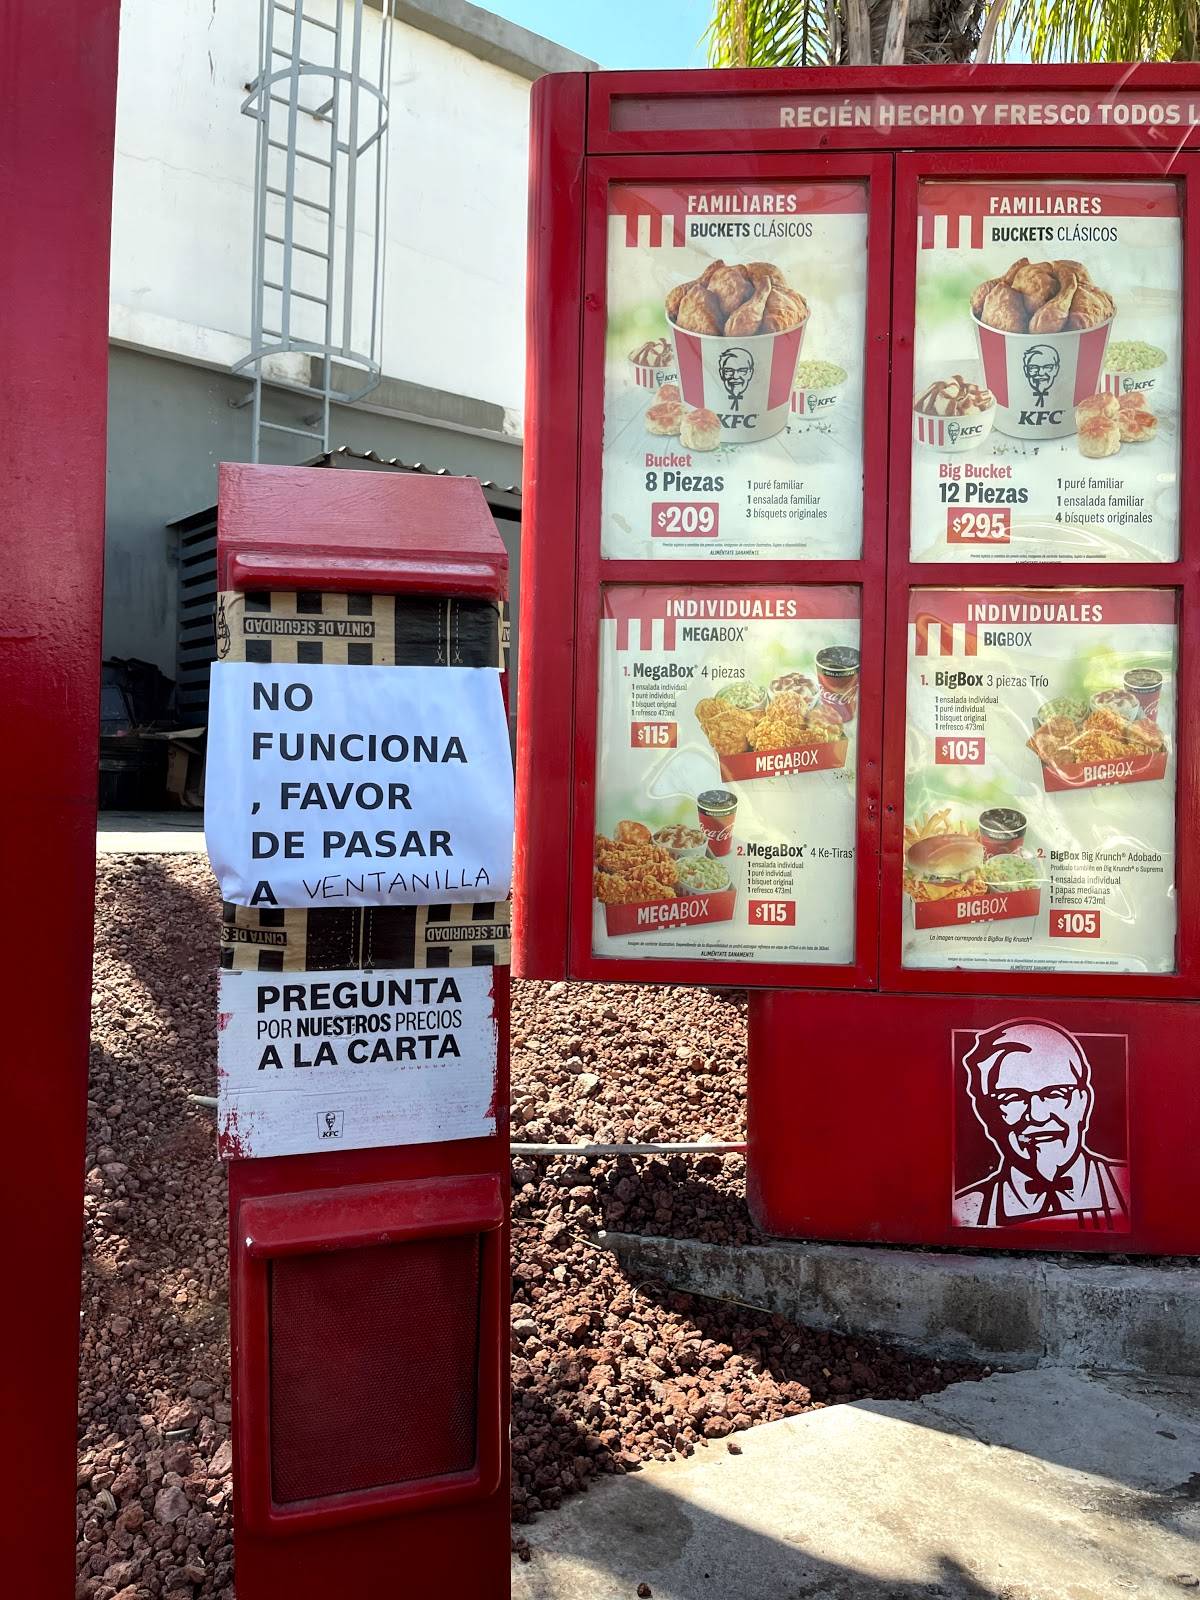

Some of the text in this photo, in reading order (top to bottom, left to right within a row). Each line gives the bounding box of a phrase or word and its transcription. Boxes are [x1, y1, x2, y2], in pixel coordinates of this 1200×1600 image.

[779, 99, 871, 128] RECIÉN
[879, 104, 964, 127] HECHO
[970, 104, 988, 126] Y
[994, 104, 1091, 126] FRESCO
[1097, 103, 1181, 126] TODOS
[687, 194, 797, 213] FAMILIARES
[989, 196, 1102, 215] FAMILIARES
[690, 219, 813, 238] BUCKETS CLÁSICOS
[991, 223, 1118, 241] BUCKETS CLÁSICOS
[1133, 379, 1156, 390] KFC
[817, 396, 837, 406] KFC
[1018, 410, 1064, 426] KFC
[959, 424, 983, 436] KFC
[645, 453, 692, 468] Bucket
[939, 464, 1012, 480] Big Bucket
[645, 471, 725, 492] 8 Piezas
[747, 480, 804, 492] 1 puré familiar
[1057, 478, 1124, 492] 1 puré familiar
[747, 495, 821, 505] 1 ensalada familiar
[938, 481, 1029, 504] 12 Piezas
[1057, 495, 1145, 507] 1 ensalada familiar
[657, 506, 715, 533] $209
[745, 508, 752, 518] 3
[788, 508, 828, 520] originales
[1055, 512, 1063, 522] 4
[1106, 512, 1153, 525] originales
[952, 512, 1006, 538] $295
[666, 599, 797, 617] INDIVIDUALES
[967, 603, 1103, 622] INDIVIDUALES
[245, 619, 373, 636] CINTA DE SEGURIDAD
[983, 631, 1032, 647] BIGBOX
[623, 666, 631, 677] 1.
[701, 665, 708, 678] 4
[711, 665, 745, 680] piezas
[920, 671, 1049, 691] 1. BigBox 3 piezas Trío
[252, 681, 314, 712] NO
[939, 696, 967, 704] ensalada
[968, 696, 999, 704] individual
[939, 705, 954, 714] puré
[954, 705, 986, 713] individual
[963, 714, 987, 723] original
[637, 725, 670, 745] $115
[939, 723, 964, 731] refresco
[965, 723, 985, 731] 473ml
[251, 731, 468, 764] FUNCIONA
[942, 740, 979, 760] $105
[755, 749, 819, 773] MEGABOX
[1083, 760, 1134, 781] BIGBOX
[280, 781, 413, 811] FAVOR
[251, 829, 454, 860] DE PASAR
[736, 846, 746, 856] 2.
[810, 847, 817, 858] 4
[1037, 848, 1047, 859] 2.
[1050, 850, 1079, 863] BigBox
[1081, 851, 1093, 863] Big
[1128, 852, 1162, 862] Adobado
[751, 861, 776, 869] ensalada
[777, 861, 804, 869] individual
[765, 869, 792, 877] individual
[1140, 865, 1164, 874] Suprema
[249, 867, 490, 906] A VENTANILLA
[772, 878, 794, 887] original
[1055, 875, 1086, 884] ensalada
[1087, 876, 1121, 885] individual
[751, 886, 774, 894] refresco
[774, 886, 792, 894] 473ml
[1055, 886, 1076, 895] papas
[1077, 885, 1110, 894] medianas
[957, 897, 1008, 919] BIGBOX
[1055, 895, 1083, 904] refresco
[1084, 896, 1106, 905] 473ml
[637, 898, 709, 925] MEGABOX
[755, 903, 787, 922] $115
[1057, 913, 1096, 934] $105
[231, 928, 248, 942] DE
[249, 931, 287, 945] CINTA
[426, 926, 488, 941] SEGURIDAD
[490, 925, 504, 939] DE
[256, 976, 463, 1014] PREGUNTA
[256, 1009, 463, 1040] POR NUESTROS PRECIOS
[257, 1033, 462, 1071] A LA CARTA
